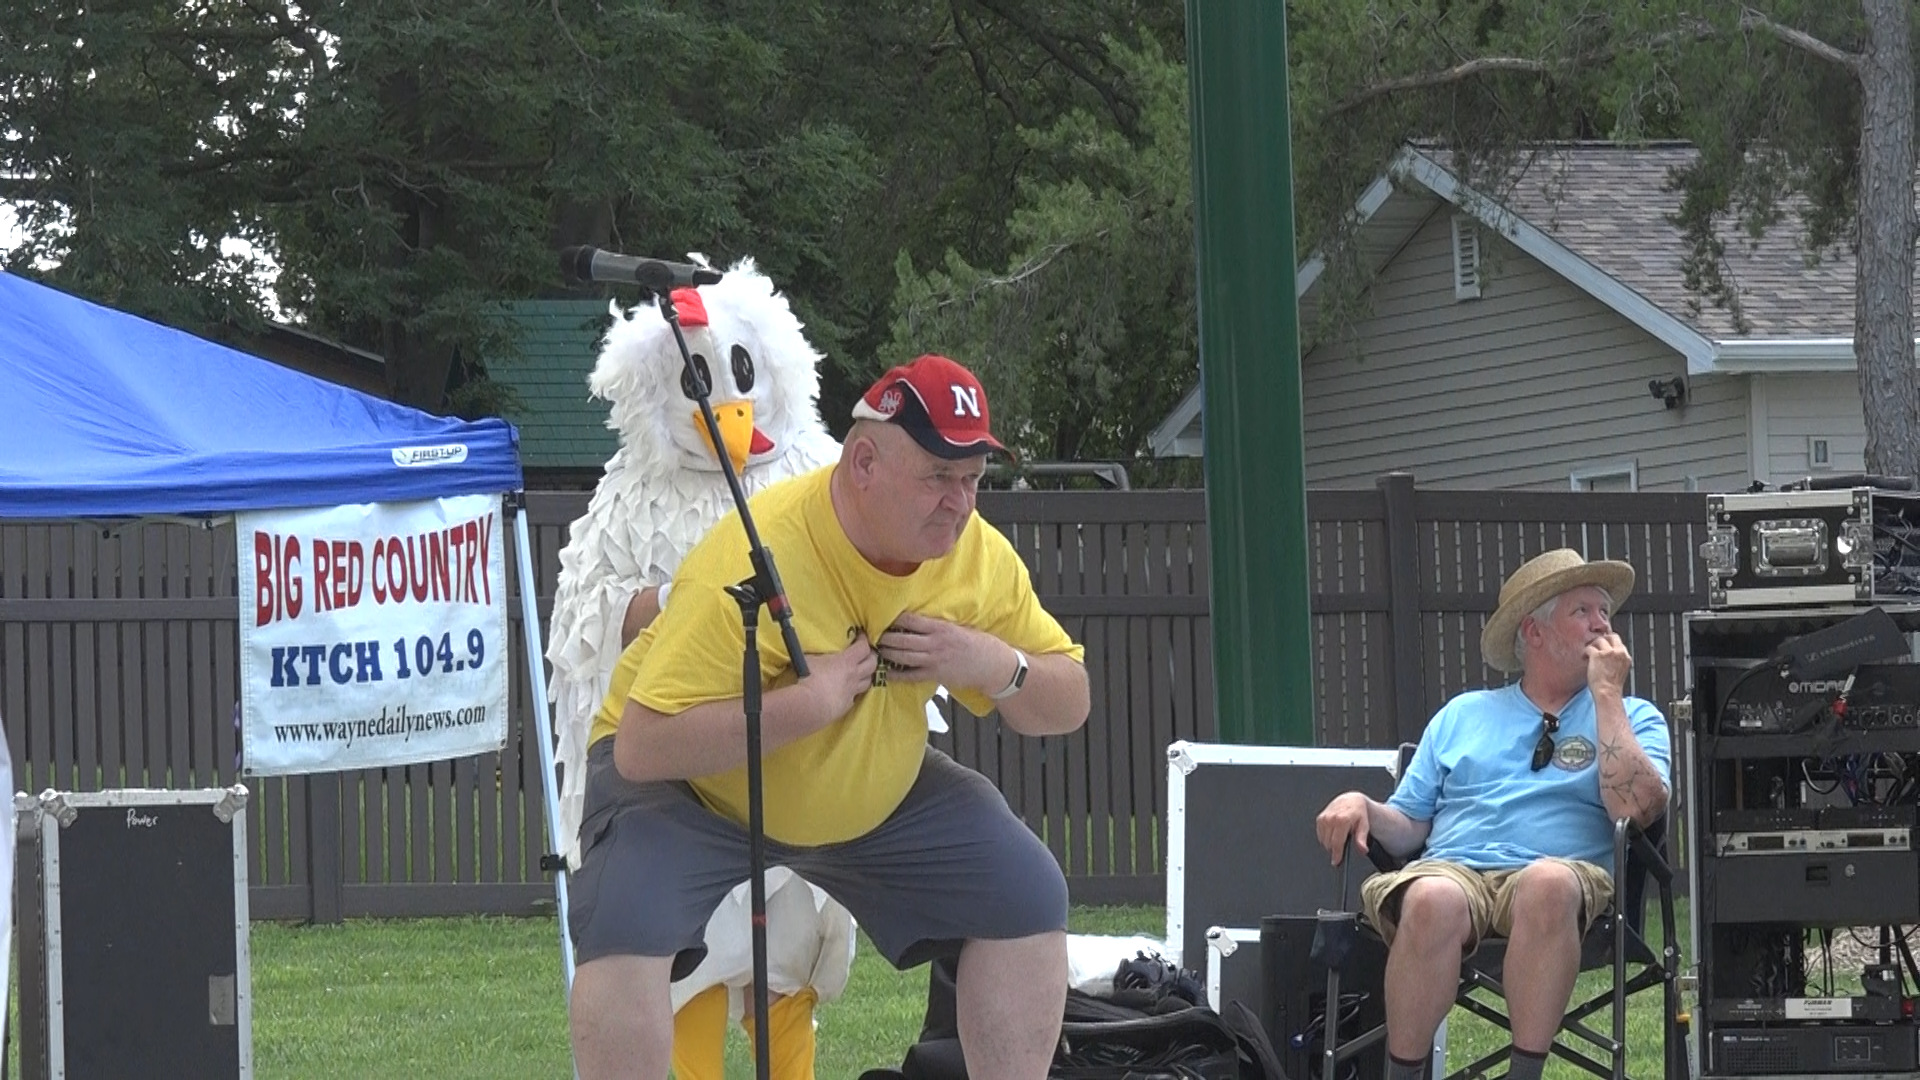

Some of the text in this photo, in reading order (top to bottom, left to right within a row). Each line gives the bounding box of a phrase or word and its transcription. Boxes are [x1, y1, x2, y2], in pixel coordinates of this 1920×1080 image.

[951, 385, 981, 418] N
[255, 512, 493, 627] BIG RED COUNTRY
[270, 628, 485, 687] KTCH 104.9
[274, 704, 487, 748] www.waynedailynews.com
[127, 808, 159, 829] Power
